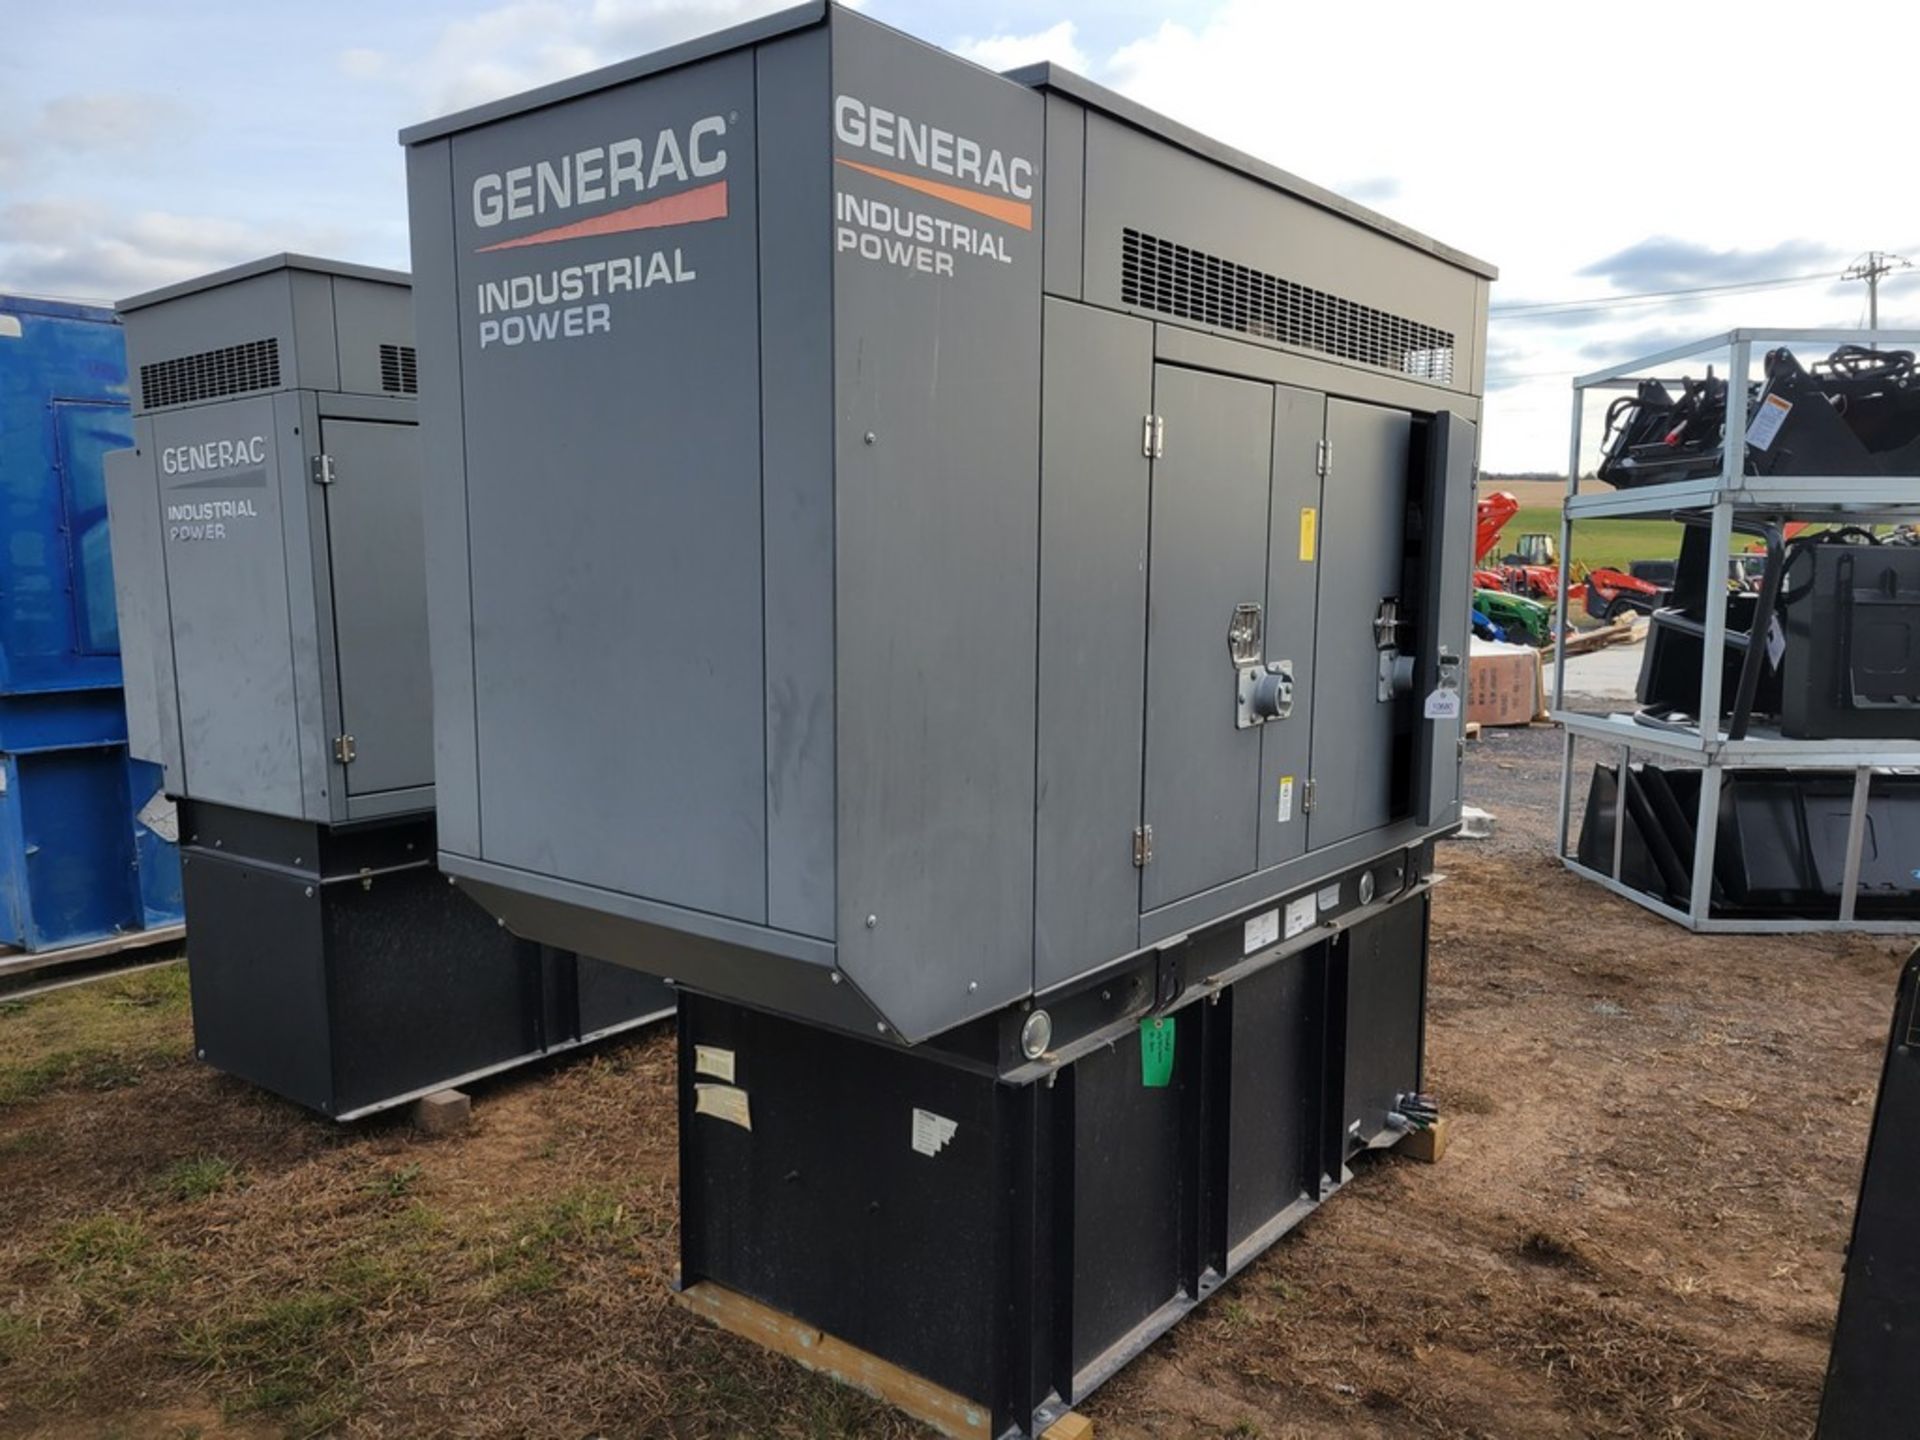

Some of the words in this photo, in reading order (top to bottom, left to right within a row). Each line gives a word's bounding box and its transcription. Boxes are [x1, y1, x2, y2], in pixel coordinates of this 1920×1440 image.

[472, 115, 728, 228] GENERAC
[834, 95, 1033, 200] GENERAC
[836, 192, 1012, 263] INDUSTRIAL
[836, 227, 954, 277] POWER
[477, 248, 696, 314] INDUSTRIAL
[479, 303, 611, 349] POWER
[162, 436, 266, 475] GENERAC
[167, 499, 258, 521] INDUSTRIAL
[169, 523, 226, 541] POWER
